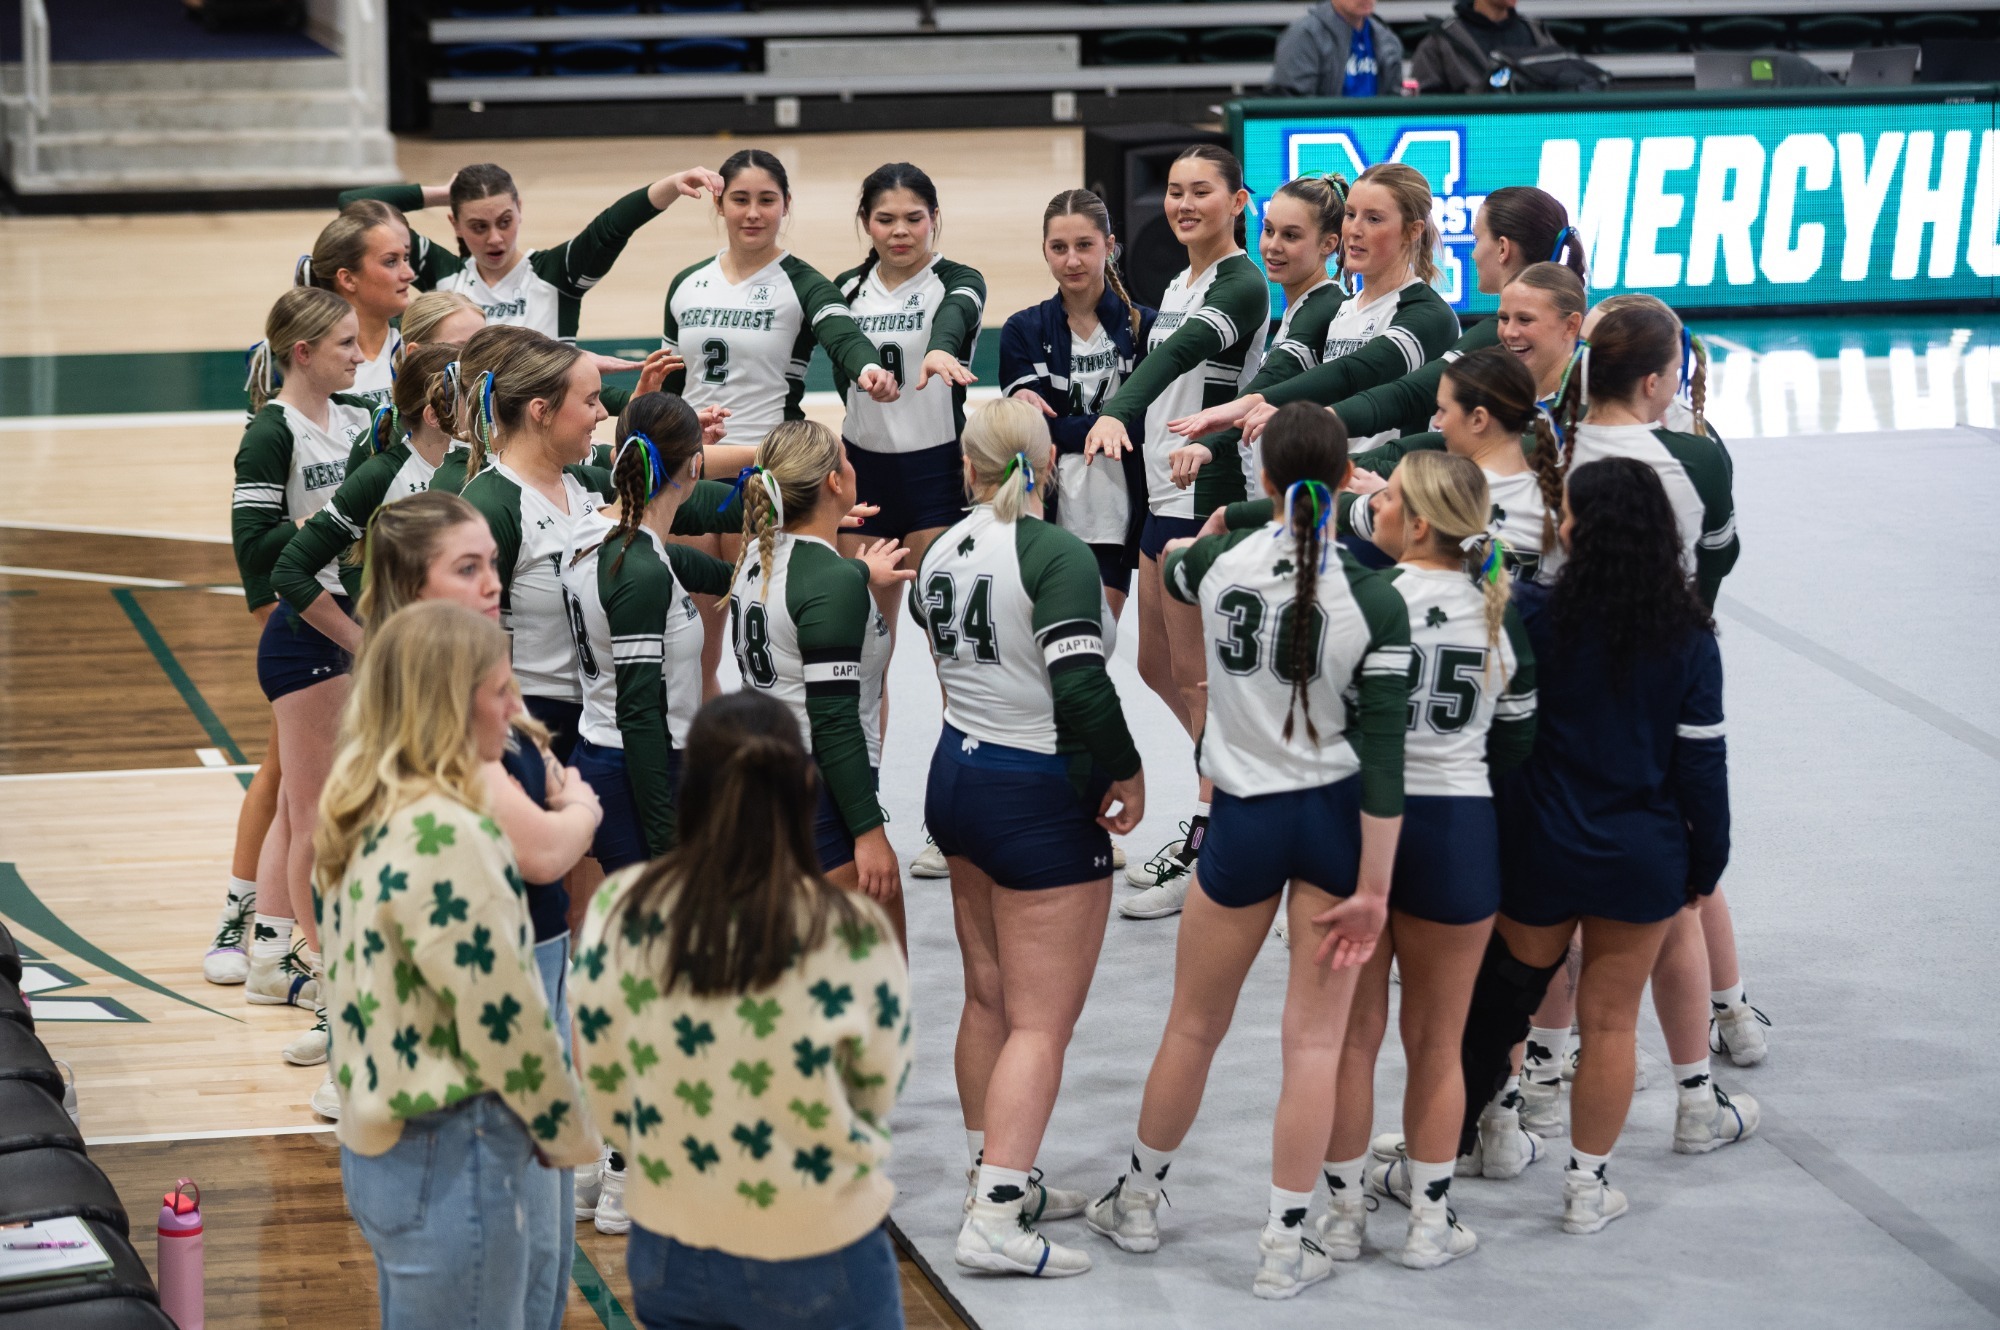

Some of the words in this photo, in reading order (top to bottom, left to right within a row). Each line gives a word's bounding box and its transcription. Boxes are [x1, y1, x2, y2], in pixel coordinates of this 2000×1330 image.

[679, 307, 776, 331] MERCYHURST
[701, 338, 729, 385] 2
[302, 458, 349, 491] MERC
[926, 571, 1000, 665] 24
[1215, 584, 1328, 685] 30
